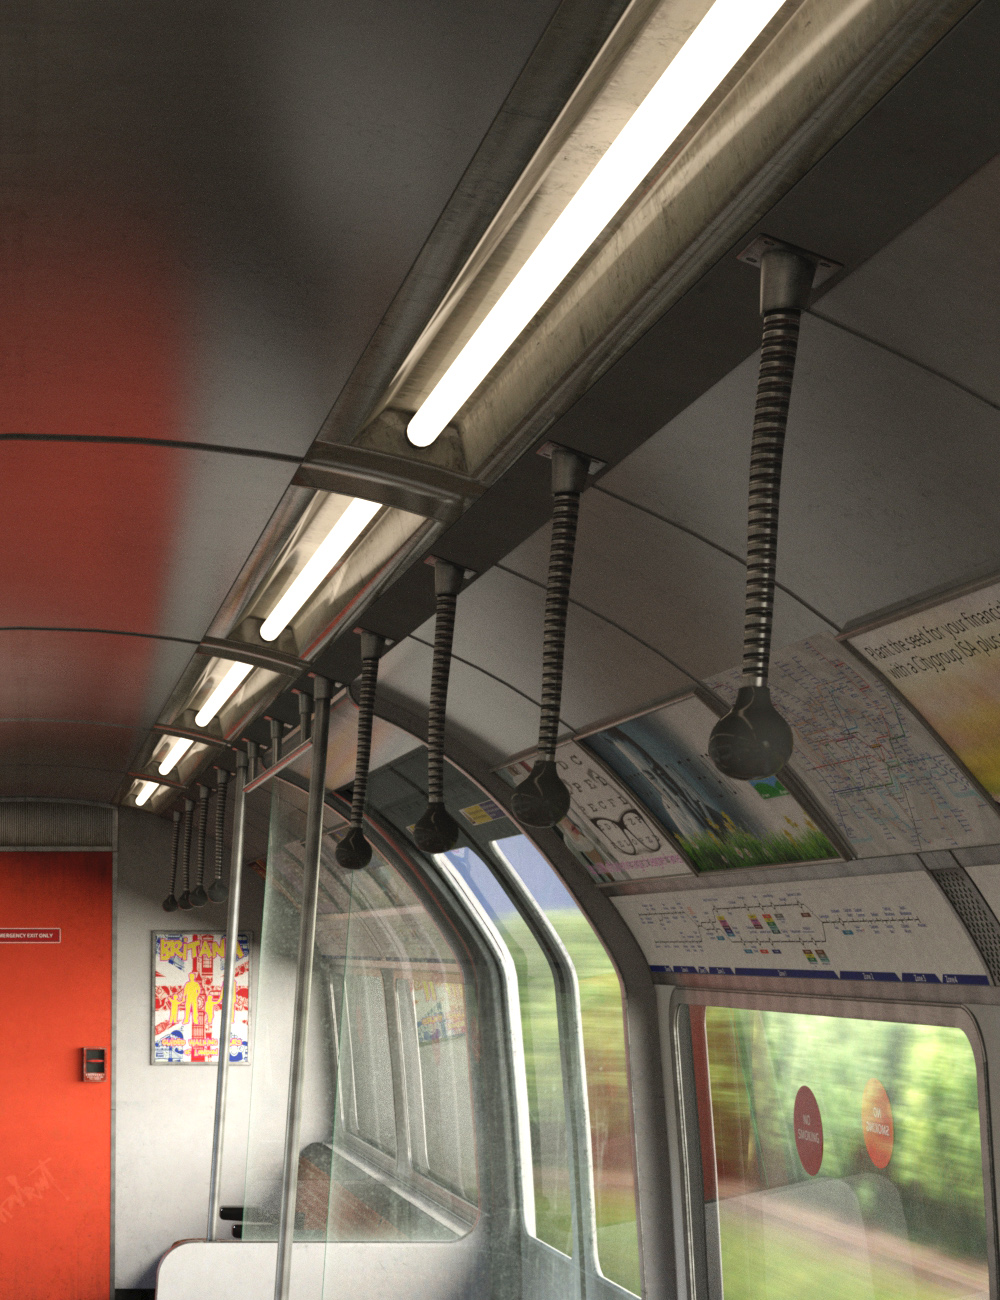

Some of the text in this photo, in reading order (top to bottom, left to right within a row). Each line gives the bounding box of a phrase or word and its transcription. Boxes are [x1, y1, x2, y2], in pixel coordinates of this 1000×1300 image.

[864, 643, 895, 660] Plant
[886, 639, 909, 652] the
[904, 628, 931, 648] seed
[922, 626, 945, 638] for
[940, 618, 969, 640] your
[954, 640, 978, 657] ISA
[906, 662, 918, 673] a
[911, 648, 964, 672] Citygroup
[887, 662, 911, 679] with
